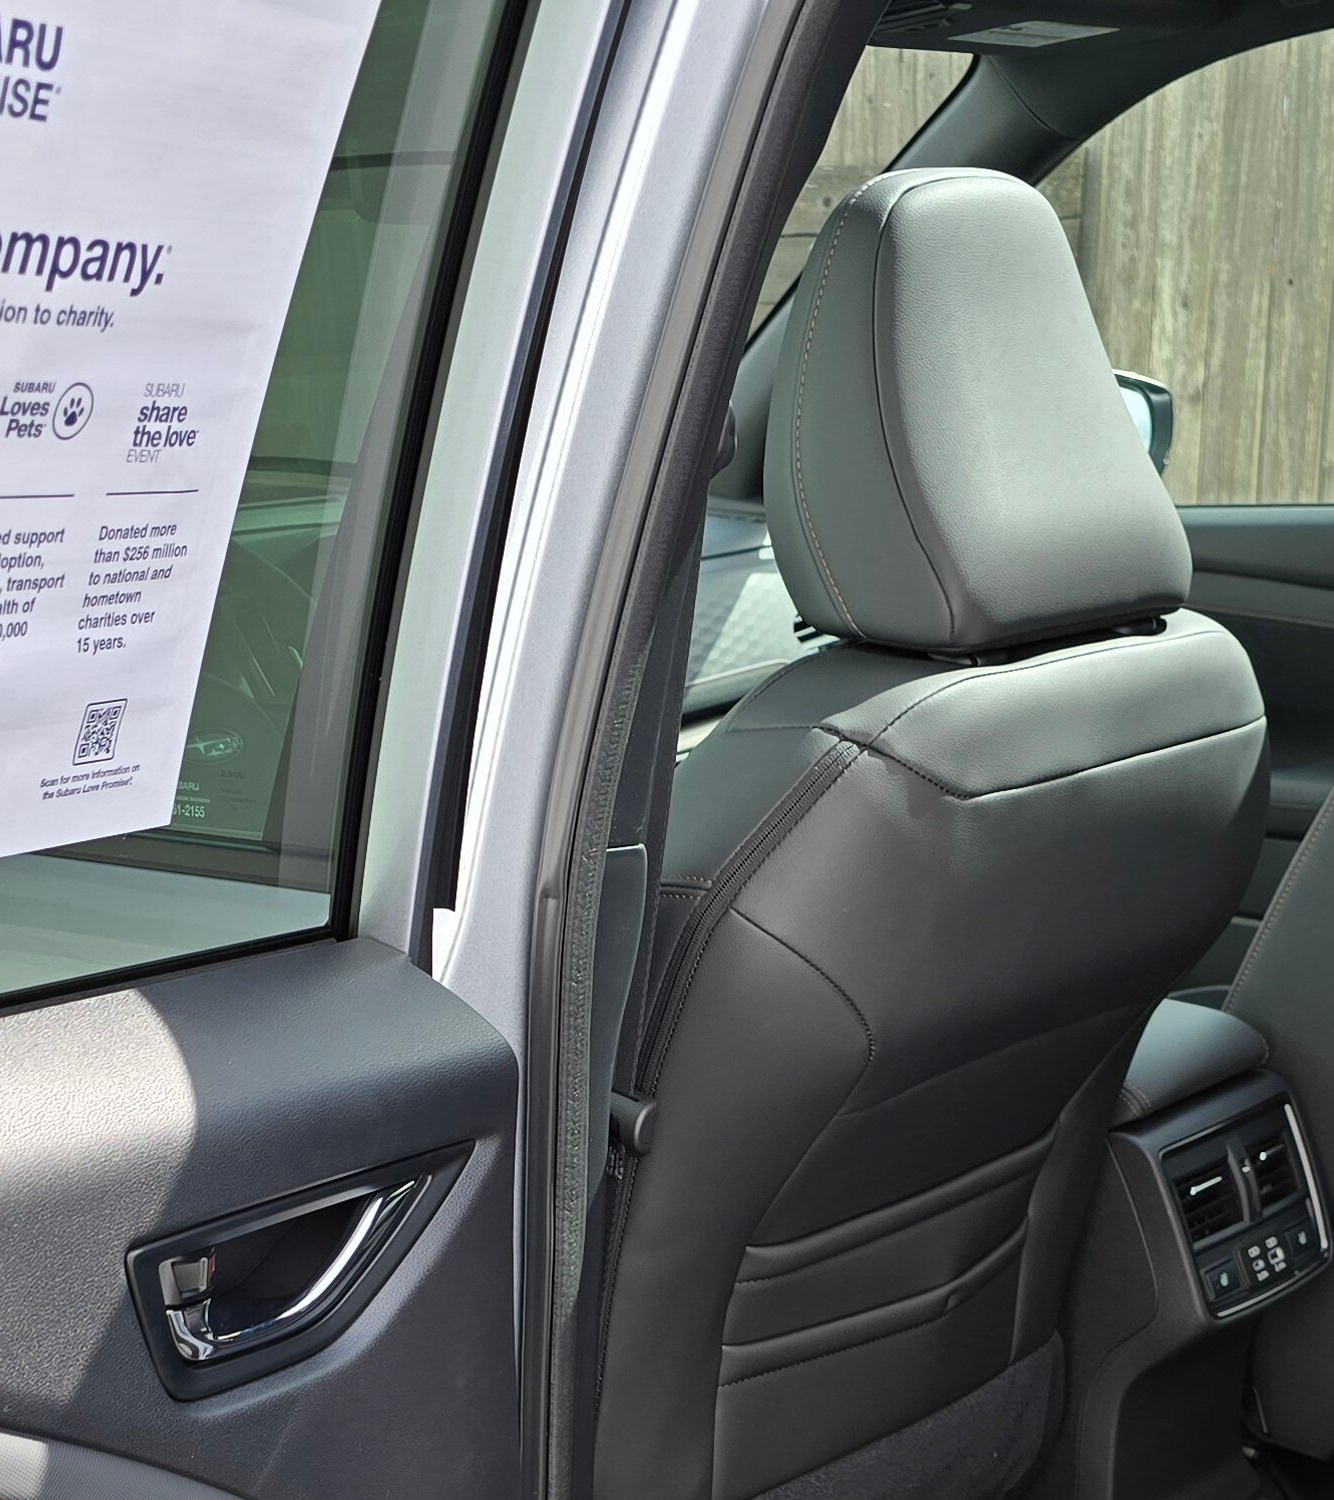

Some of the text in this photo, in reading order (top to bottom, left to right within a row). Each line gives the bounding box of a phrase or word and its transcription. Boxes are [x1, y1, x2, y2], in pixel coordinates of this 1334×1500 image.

[32, 304, 52, 326] to
[56, 304, 115, 333] charity.
[13, 381, 56, 395] SUBARU
[143, 382, 186, 398] SUBARU
[136, 400, 189, 424] share
[5, 418, 43, 439] Pets
[132, 424, 162, 449] the
[126, 449, 163, 464] EVENT
[13, 527, 66, 549] support
[98, 522, 178, 541] Donated more
[93, 542, 188, 564] than $256 million
[5, 573, 66, 595] transport
[87, 564, 173, 586] to national and
[21, 596, 37, 614] of
[82, 589, 142, 609] hometown
[77, 610, 156, 631] charities over
[76, 635, 127, 656] 15 years.
[55, 787, 82, 799] Subaru
[82, 782, 100, 793] Love
